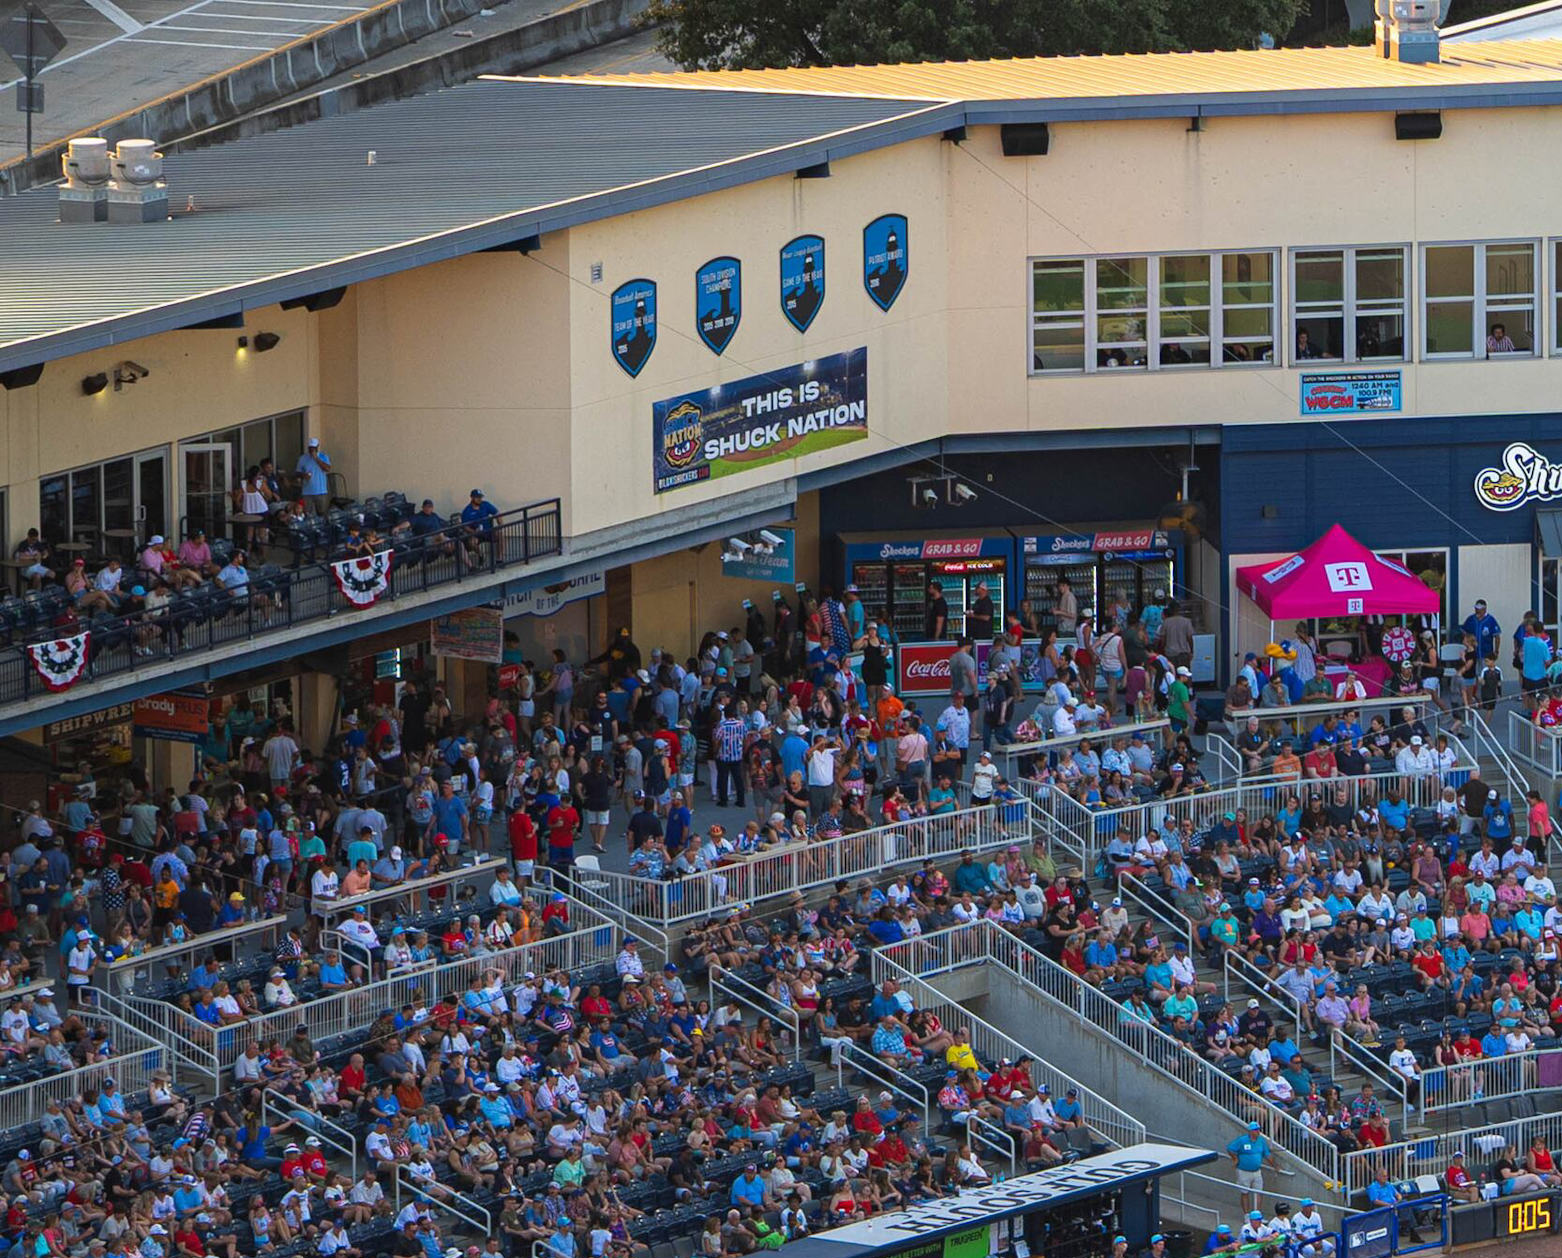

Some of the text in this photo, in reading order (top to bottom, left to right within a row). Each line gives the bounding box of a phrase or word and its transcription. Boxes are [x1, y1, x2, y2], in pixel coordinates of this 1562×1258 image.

[742, 381, 820, 418] THIS IS
[664, 424, 702, 449] NATION
[704, 400, 865, 460] SHUCK NATION
[925, 543, 952, 555] GRAB
[952, 542, 962, 553] &
[962, 541, 977, 553] GO
[1096, 535, 1122, 548] GRAB
[1123, 535, 1132, 546] &
[1133, 534, 1148, 546] GO
[1336, 567, 1360, 586] T
[885, 1160, 1161, 1235] GULF SOUTH
